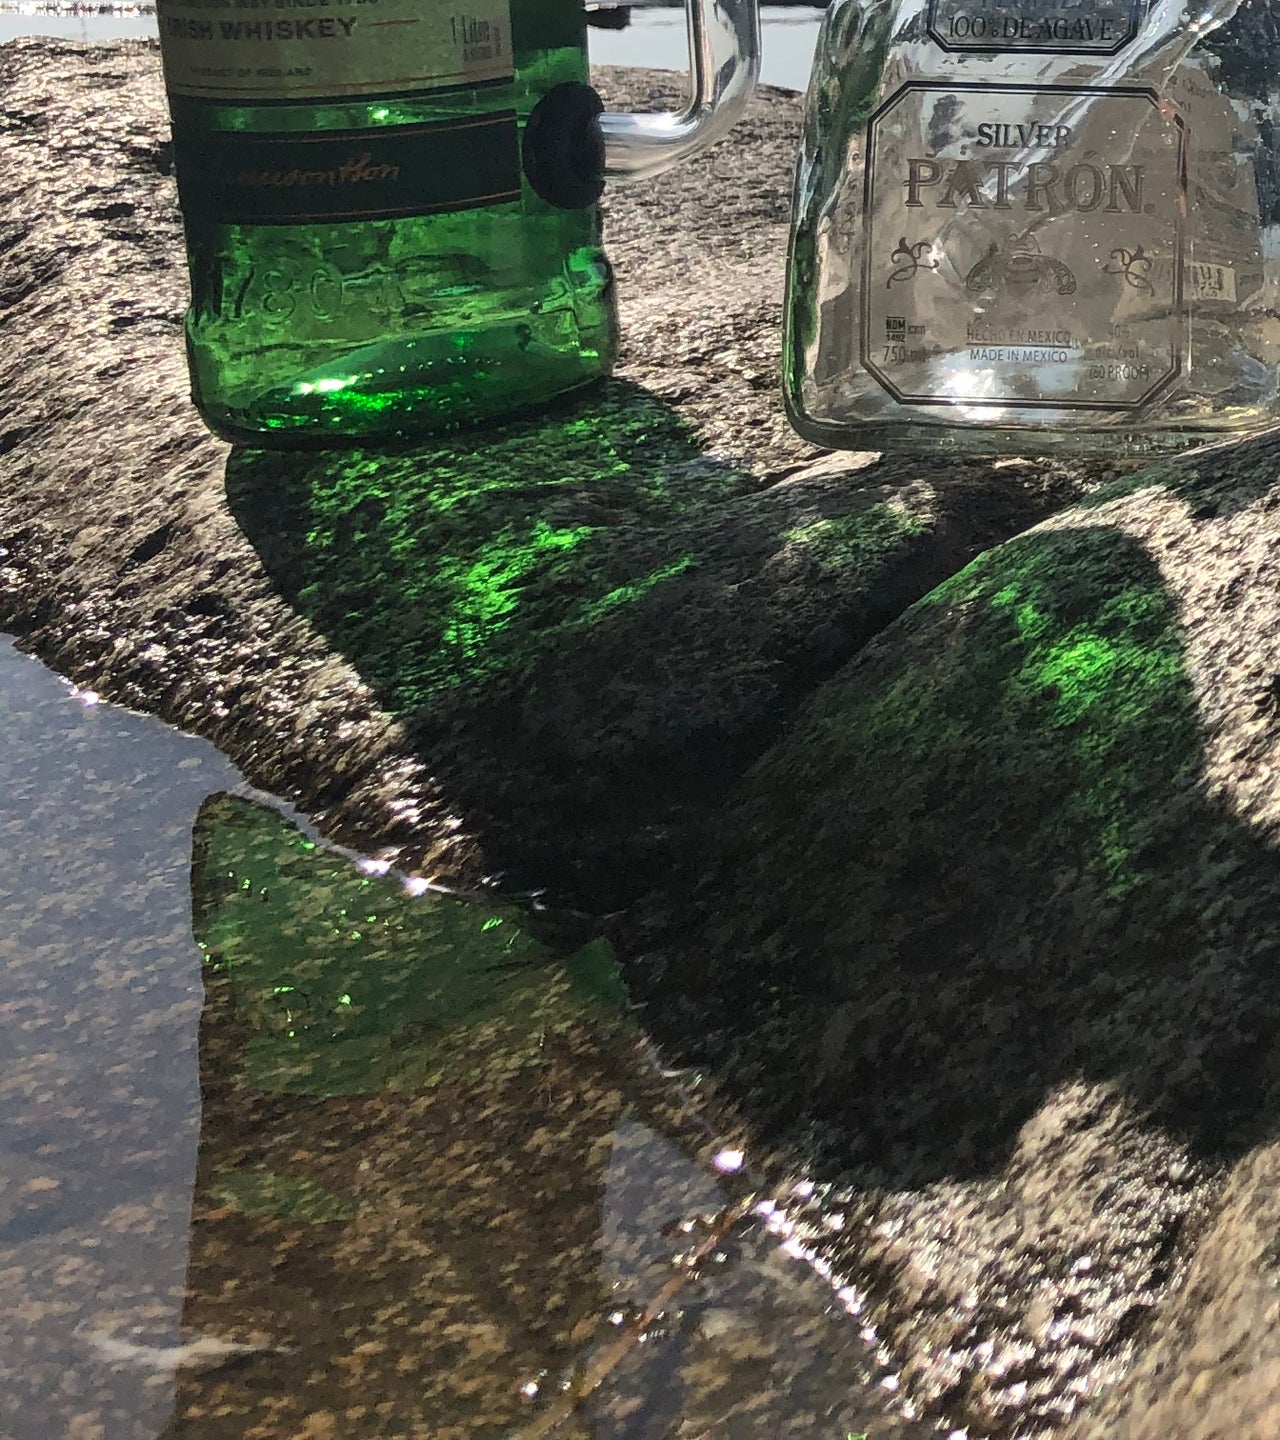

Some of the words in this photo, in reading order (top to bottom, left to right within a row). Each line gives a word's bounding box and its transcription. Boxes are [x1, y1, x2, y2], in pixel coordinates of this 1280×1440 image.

[219, 16, 357, 41] WHISKEY
[948, 16, 998, 38] 100%
[976, 120, 1073, 148] SILVER
[886, 319, 906, 330] NOM
[1027, 330, 1072, 345] MEXICO
[882, 345, 906, 363] 750
[970, 348, 1004, 362] MADE
[1007, 349, 1020, 362] IN
[1022, 350, 1068, 364] MEXICO
